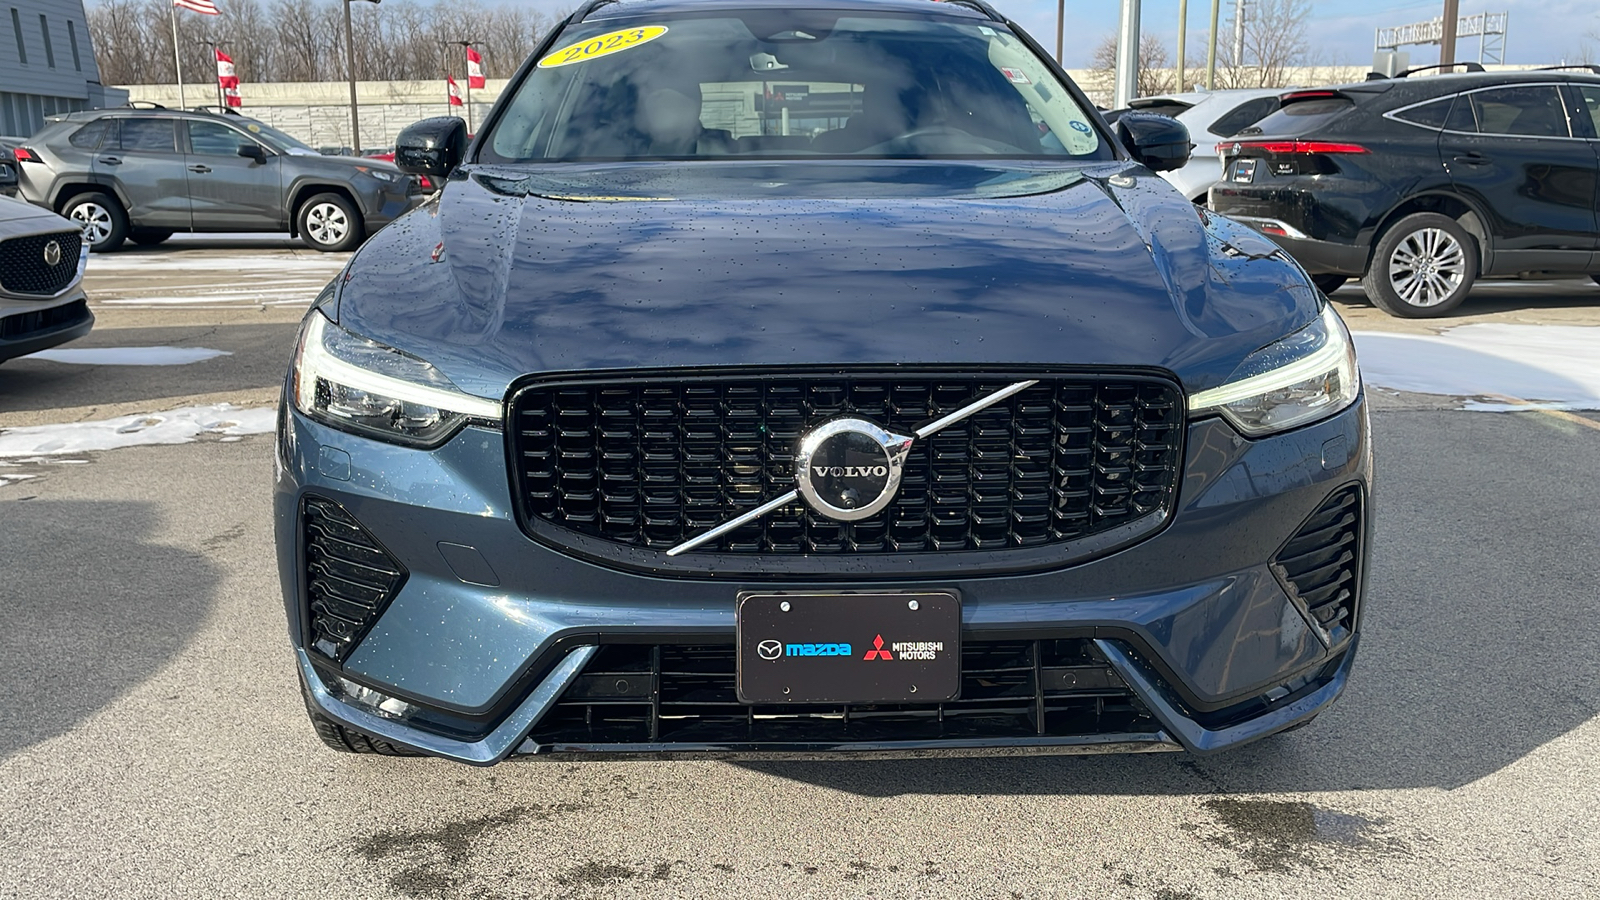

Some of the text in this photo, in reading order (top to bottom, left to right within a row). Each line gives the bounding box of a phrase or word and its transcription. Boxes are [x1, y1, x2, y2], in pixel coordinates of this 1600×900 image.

[563, 29, 645, 63] 2023
[812, 466, 887, 477] VOLVO
[892, 642, 943, 651] MITSUBISHI
[899, 651, 936, 660] MOTORS
